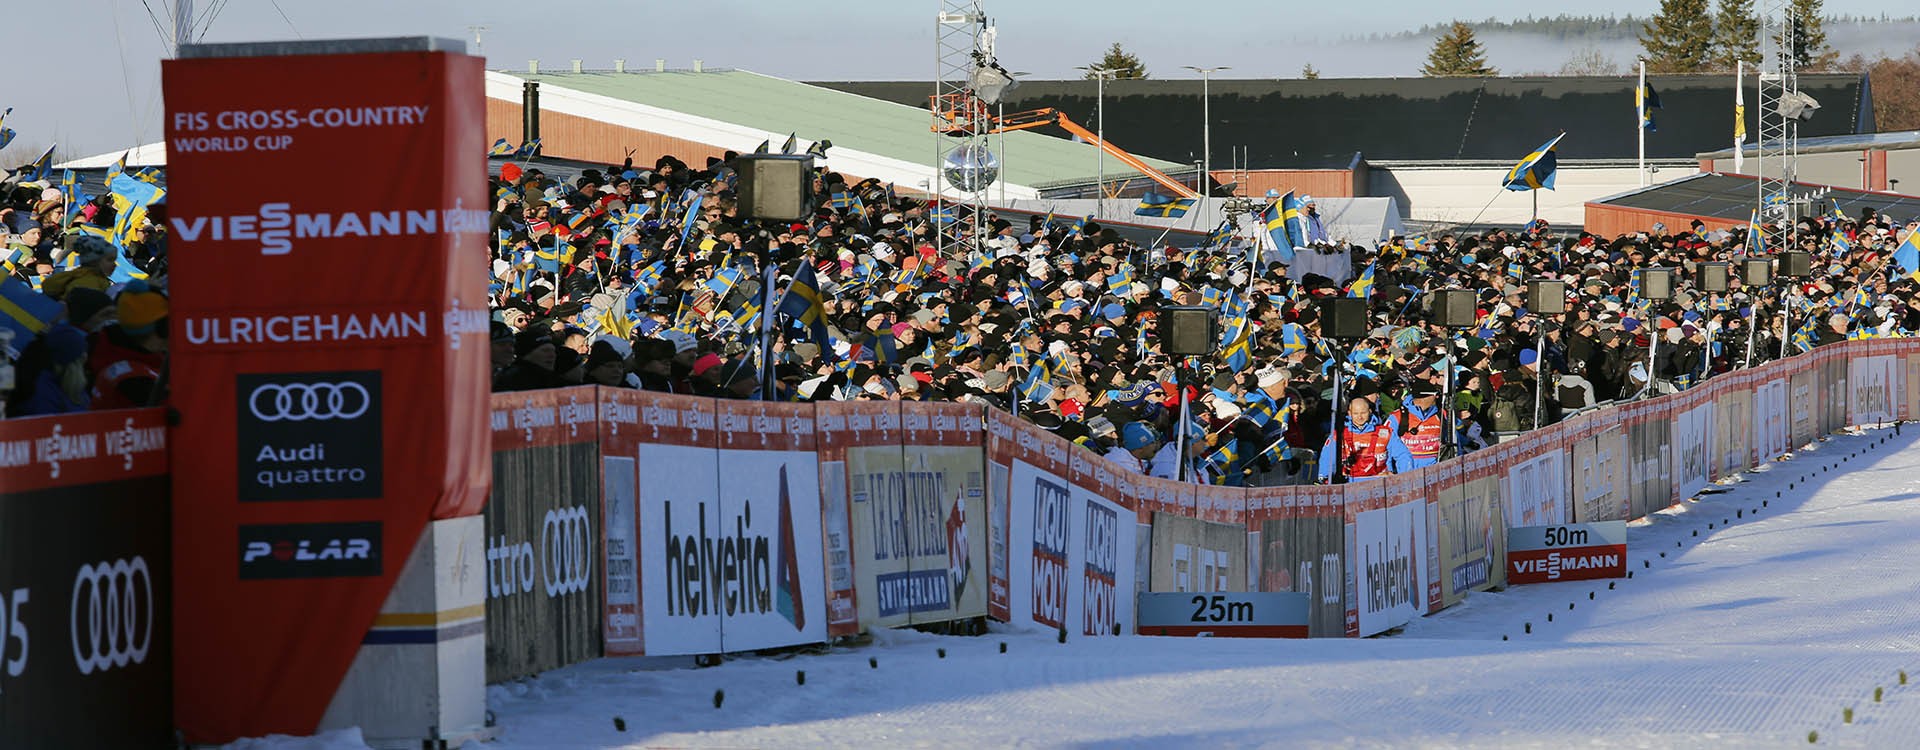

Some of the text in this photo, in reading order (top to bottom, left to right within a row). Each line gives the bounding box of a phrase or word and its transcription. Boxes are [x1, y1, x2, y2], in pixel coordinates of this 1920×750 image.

[174, 106, 429, 131] FIS CROSS-COUNTRY
[174, 136, 293, 152] WORLD CUP
[170, 202, 437, 255] VIESSMANN
[185, 311, 427, 344] ULRICEHAMN
[256, 443, 325, 462] Audi
[256, 467, 366, 488] quattro
[1544, 526, 1588, 547] 50m
[243, 538, 371, 563] POLAR
[664, 499, 772, 618] helvetia
[487, 534, 535, 599] ttro
[1365, 535, 1409, 613] helvetia
[1513, 552, 1618, 579] VIESSMANN
[879, 575, 948, 612] SWITZERLAND
[1191, 595, 1254, 622] 25m
[0, 587, 30, 677] 5
